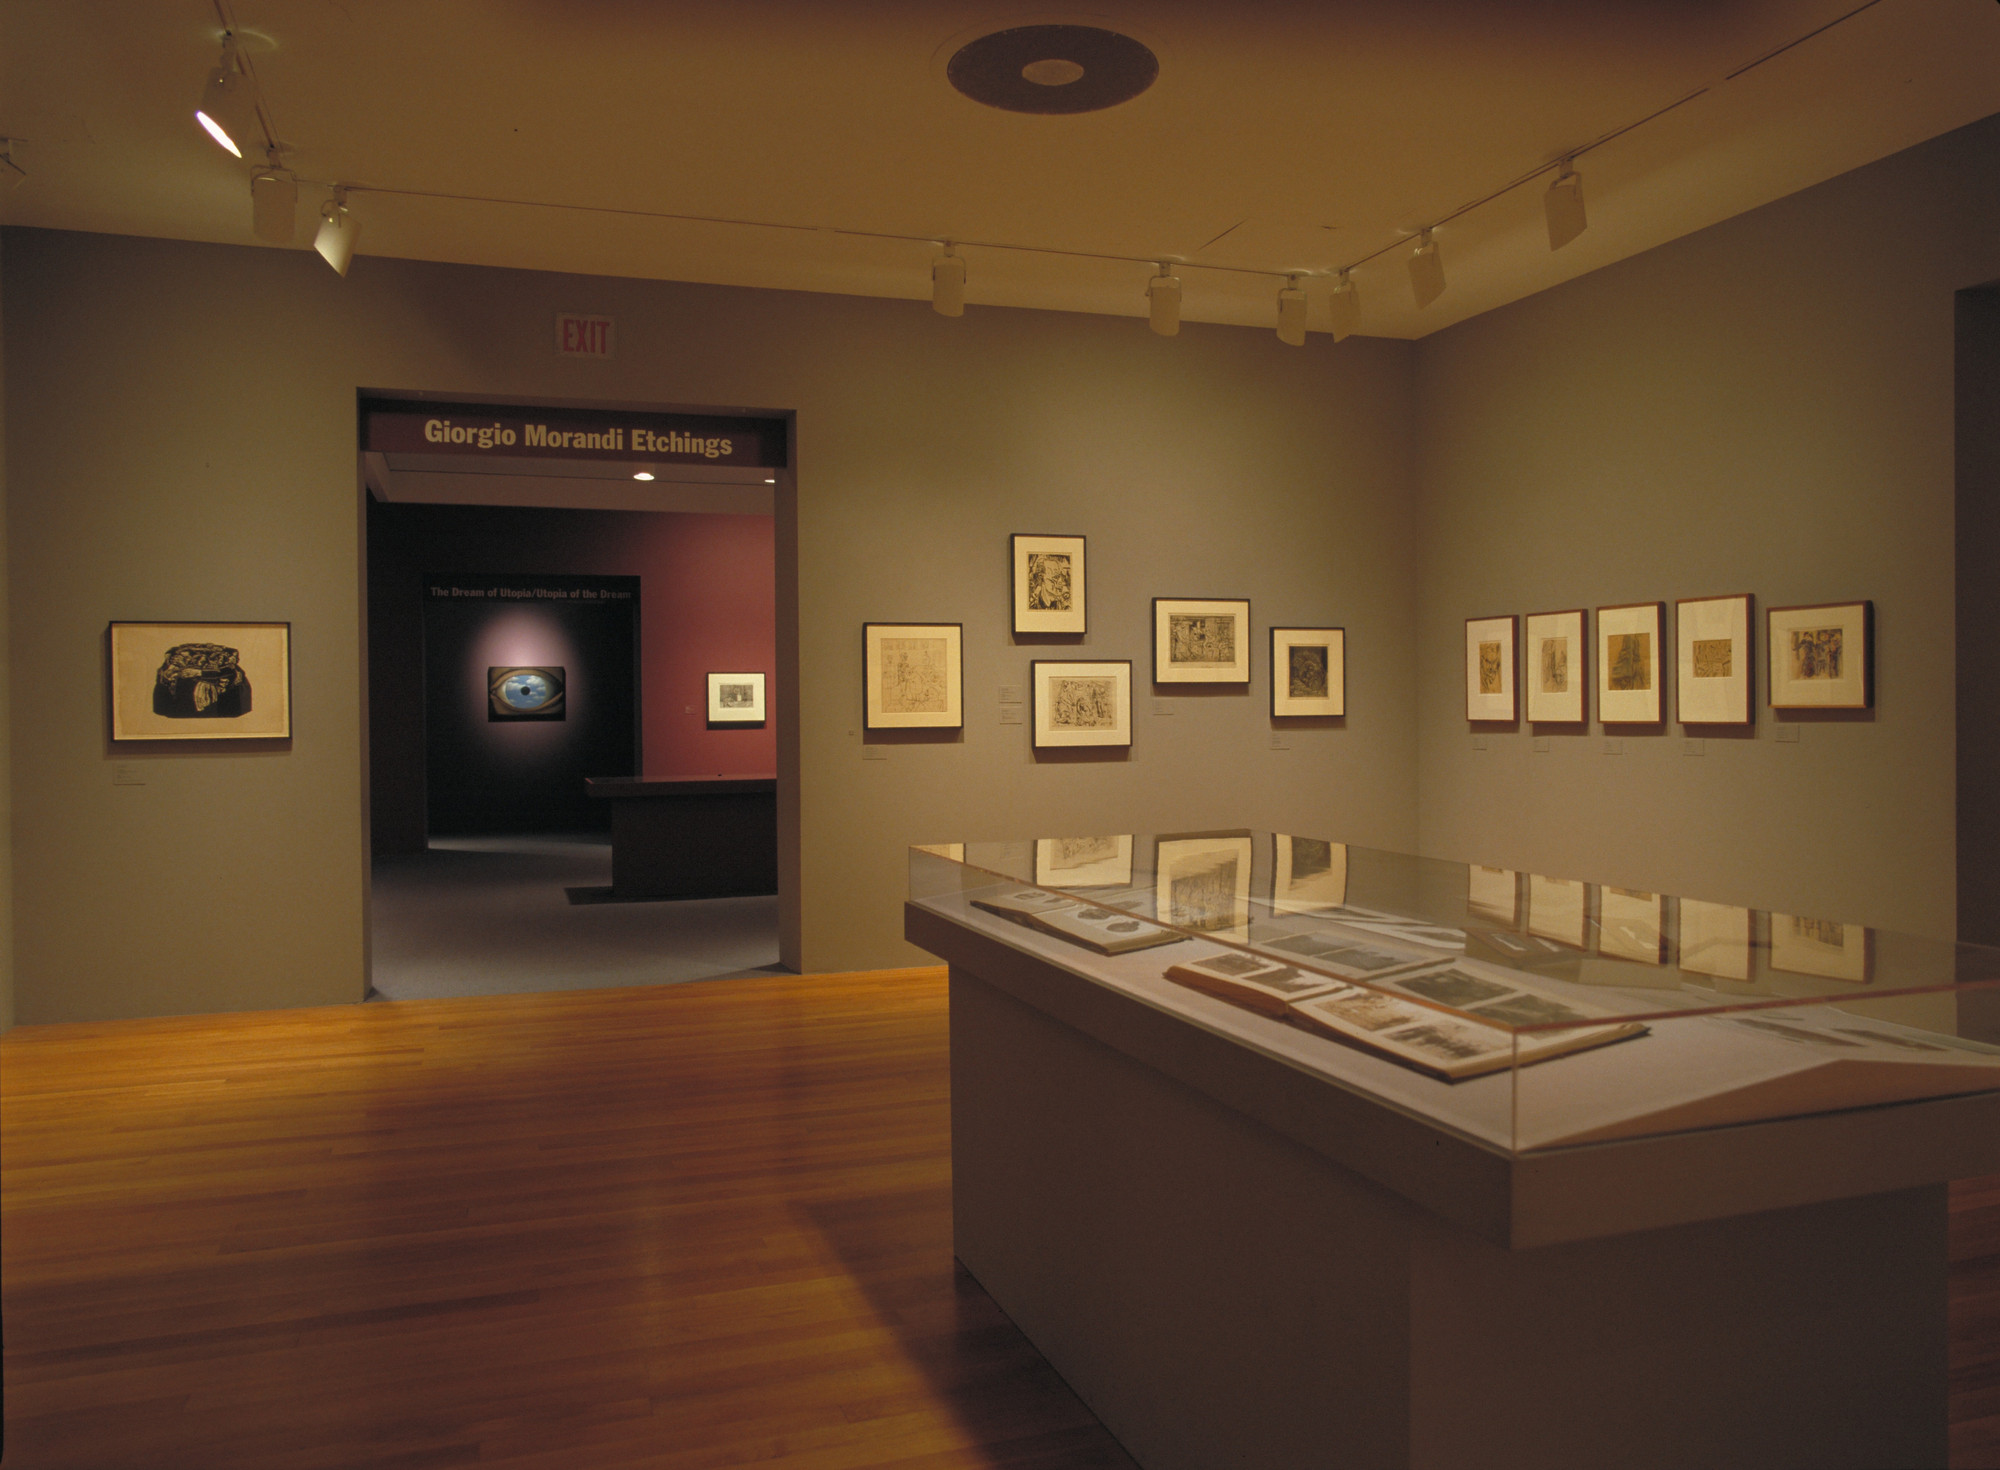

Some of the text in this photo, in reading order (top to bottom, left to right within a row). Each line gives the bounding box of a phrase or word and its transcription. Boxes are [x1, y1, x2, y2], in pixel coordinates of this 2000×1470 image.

[563, 319, 610, 354] EXIT
[424, 419, 733, 458] Giorgio Morandi Etchings
[430, 587, 632, 599] The Dream of Utopia/Utopia of the Dream
